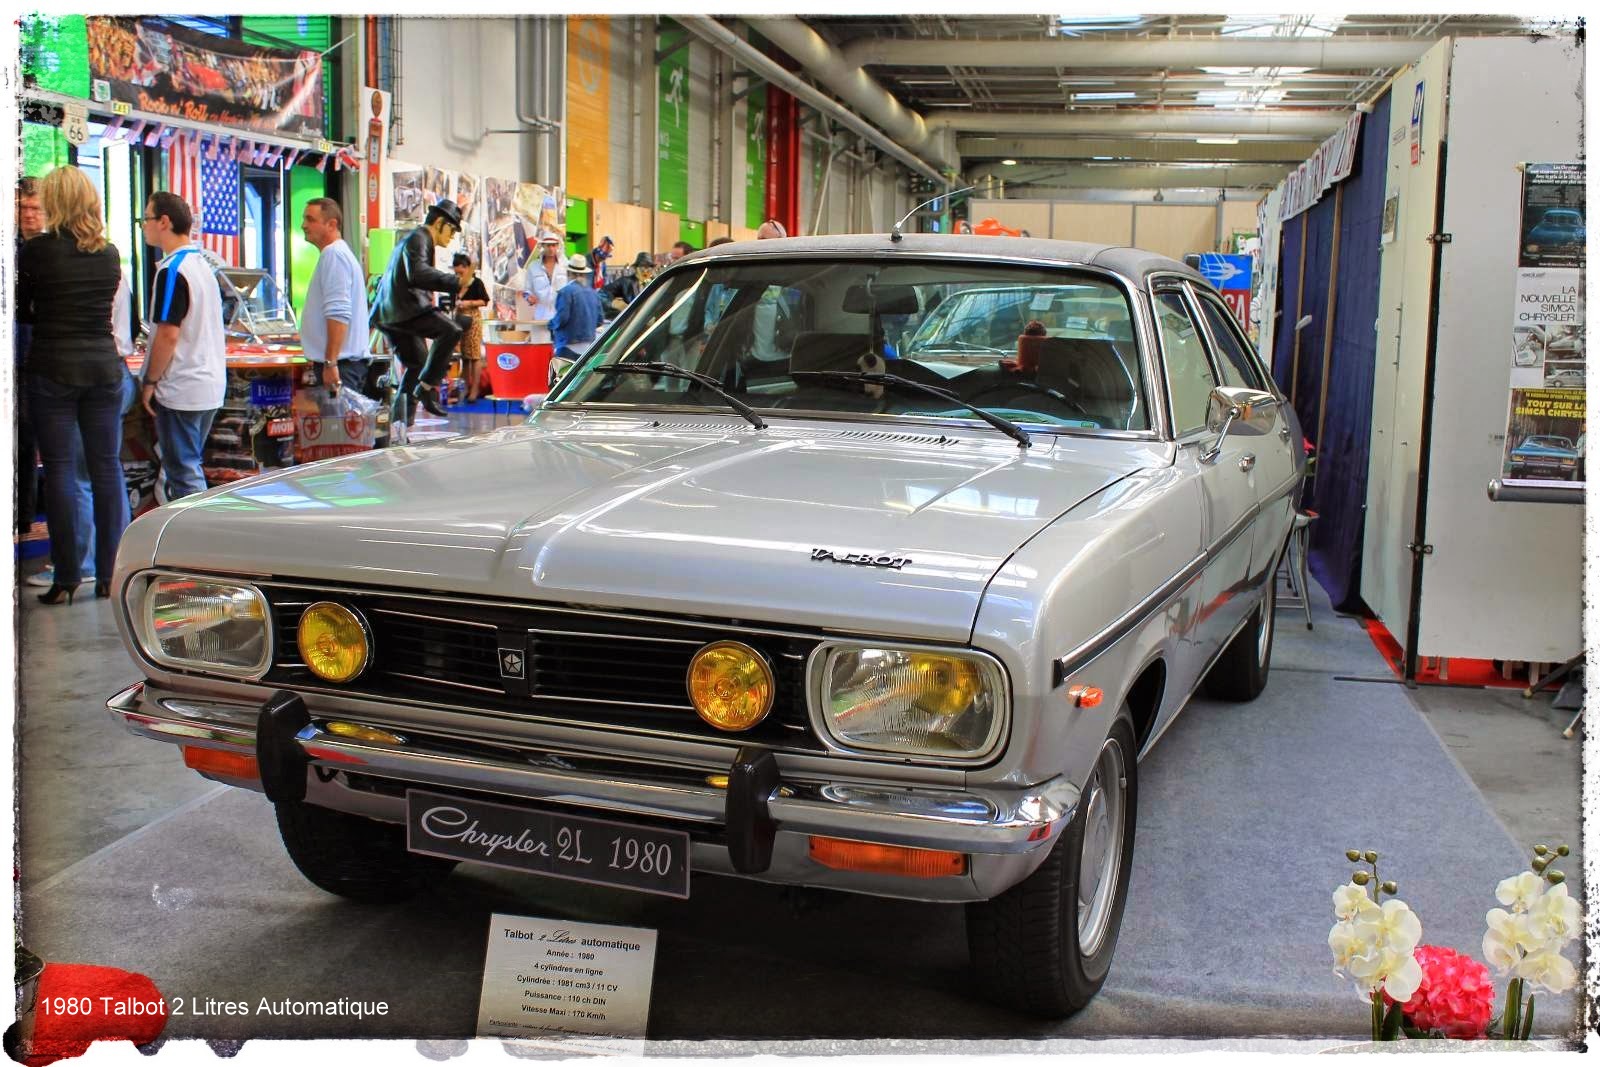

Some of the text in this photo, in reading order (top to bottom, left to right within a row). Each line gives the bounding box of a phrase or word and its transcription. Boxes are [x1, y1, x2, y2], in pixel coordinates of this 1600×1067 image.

[69, 125, 84, 141] 66
[1562, 286, 1576, 294] LA
[1520, 294, 1576, 303] NOUVELLE
[1541, 304, 1575, 313] SIMCA
[1519, 312, 1575, 321] CHRYSLER
[1515, 407, 1545, 416] SIMCA
[1527, 400, 1552, 408] TOUT
[1553, 402, 1572, 410] SUR
[810, 548, 912, 570] TALBOT
[421, 806, 672, 876] Chrysler 2L 1980
[504, 929, 533, 940] Talbot
[581, 938, 641, 951] automatique
[546, 949, 570, 958] Année
[578, 952, 595, 960] 1980
[540, 963, 573, 972] cylindres
[585, 968, 604, 976] ligne
[516, 974, 551, 985] Cylindrée
[557, 979, 573, 988] 1981
[575, 981, 591, 990] cm3
[596, 983, 605, 991] 11
[606, 984, 618, 992] CV
[524, 990, 562, 1001] Puissance
[567, 994, 581, 1003] 110
[581, 996, 591, 1004] ch
[592, 997, 607, 1006] DIN
[521, 1004, 548, 1014] Vitesse
[549, 1007, 567, 1016] Maxi
[572, 1009, 586, 1018] 170
[586, 1011, 607, 1020] Km/h
